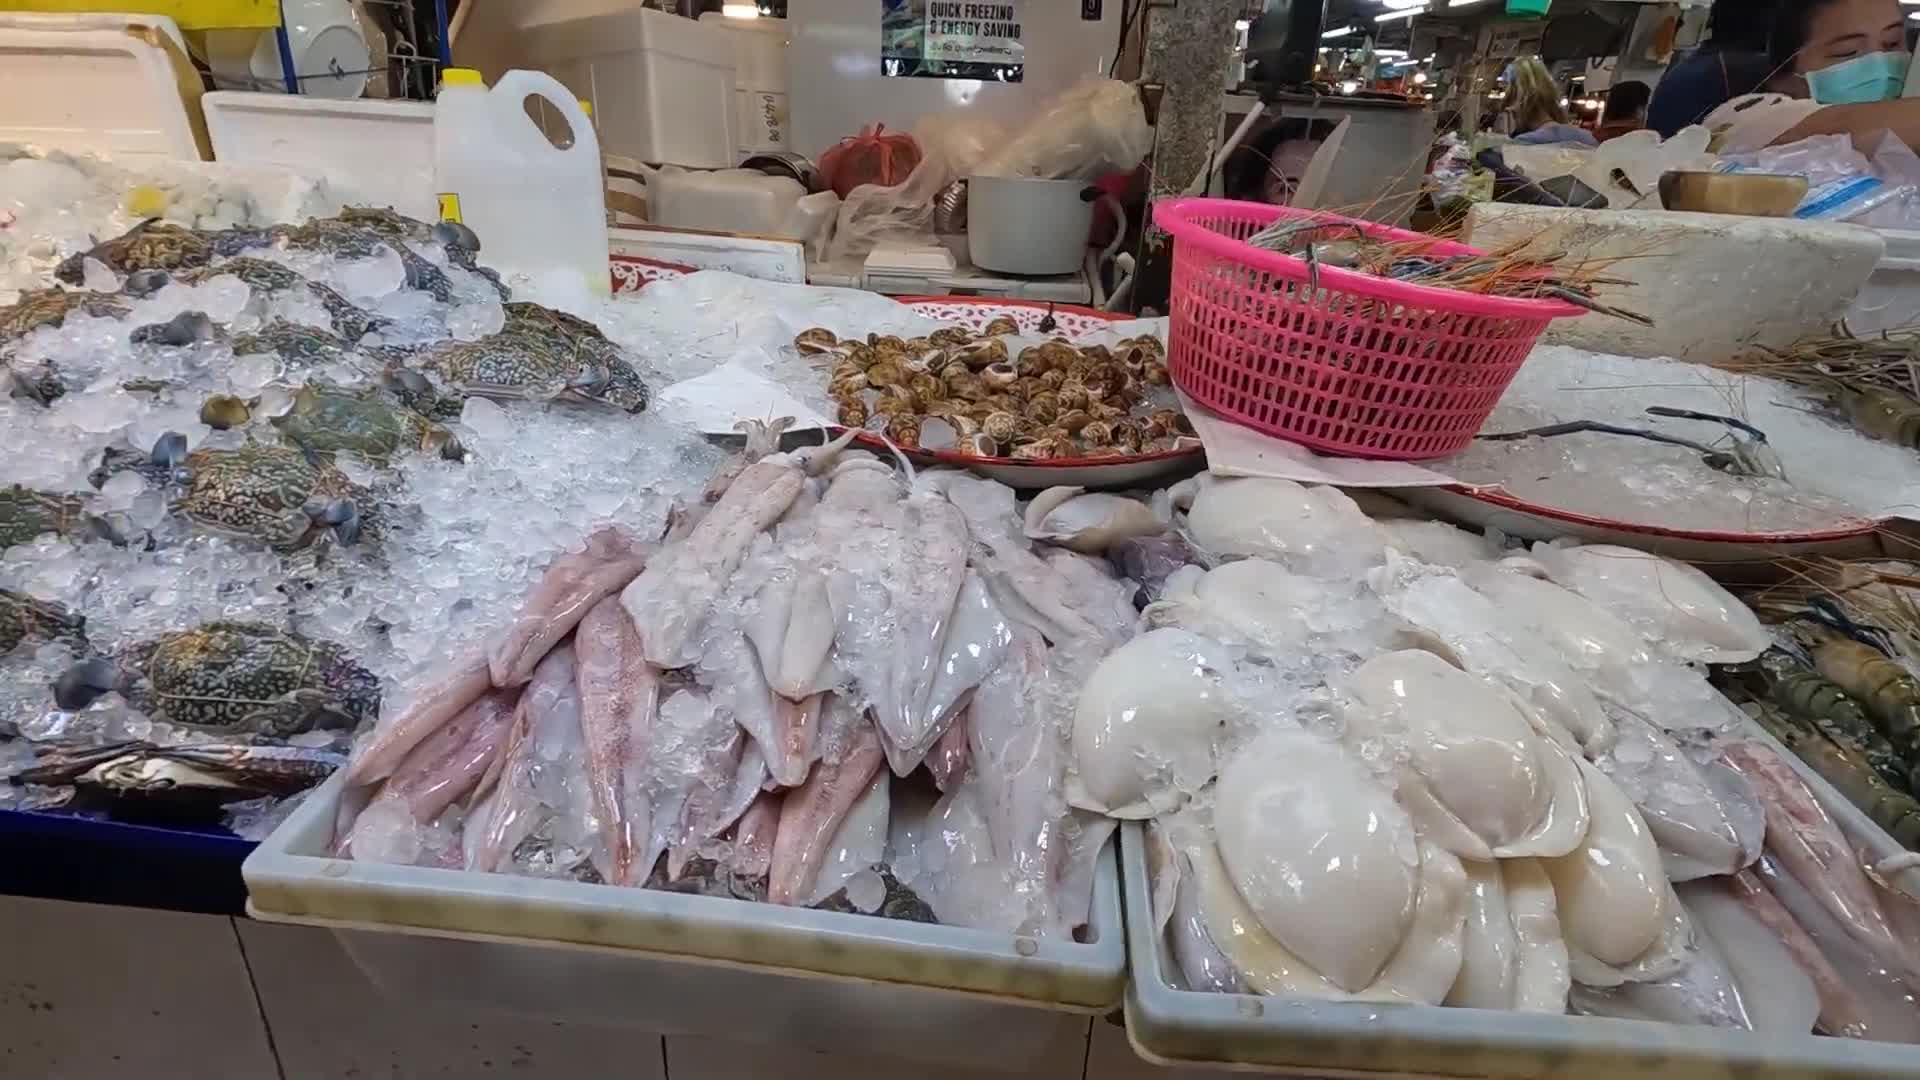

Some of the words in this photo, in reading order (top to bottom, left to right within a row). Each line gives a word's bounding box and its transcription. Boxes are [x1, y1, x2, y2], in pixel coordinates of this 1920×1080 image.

[930, 2, 961, 18] QUICK
[965, 4, 1013, 20] FREEZING
[941, 21, 980, 36] ENERGY
[983, 22, 1020, 39] SAVING
